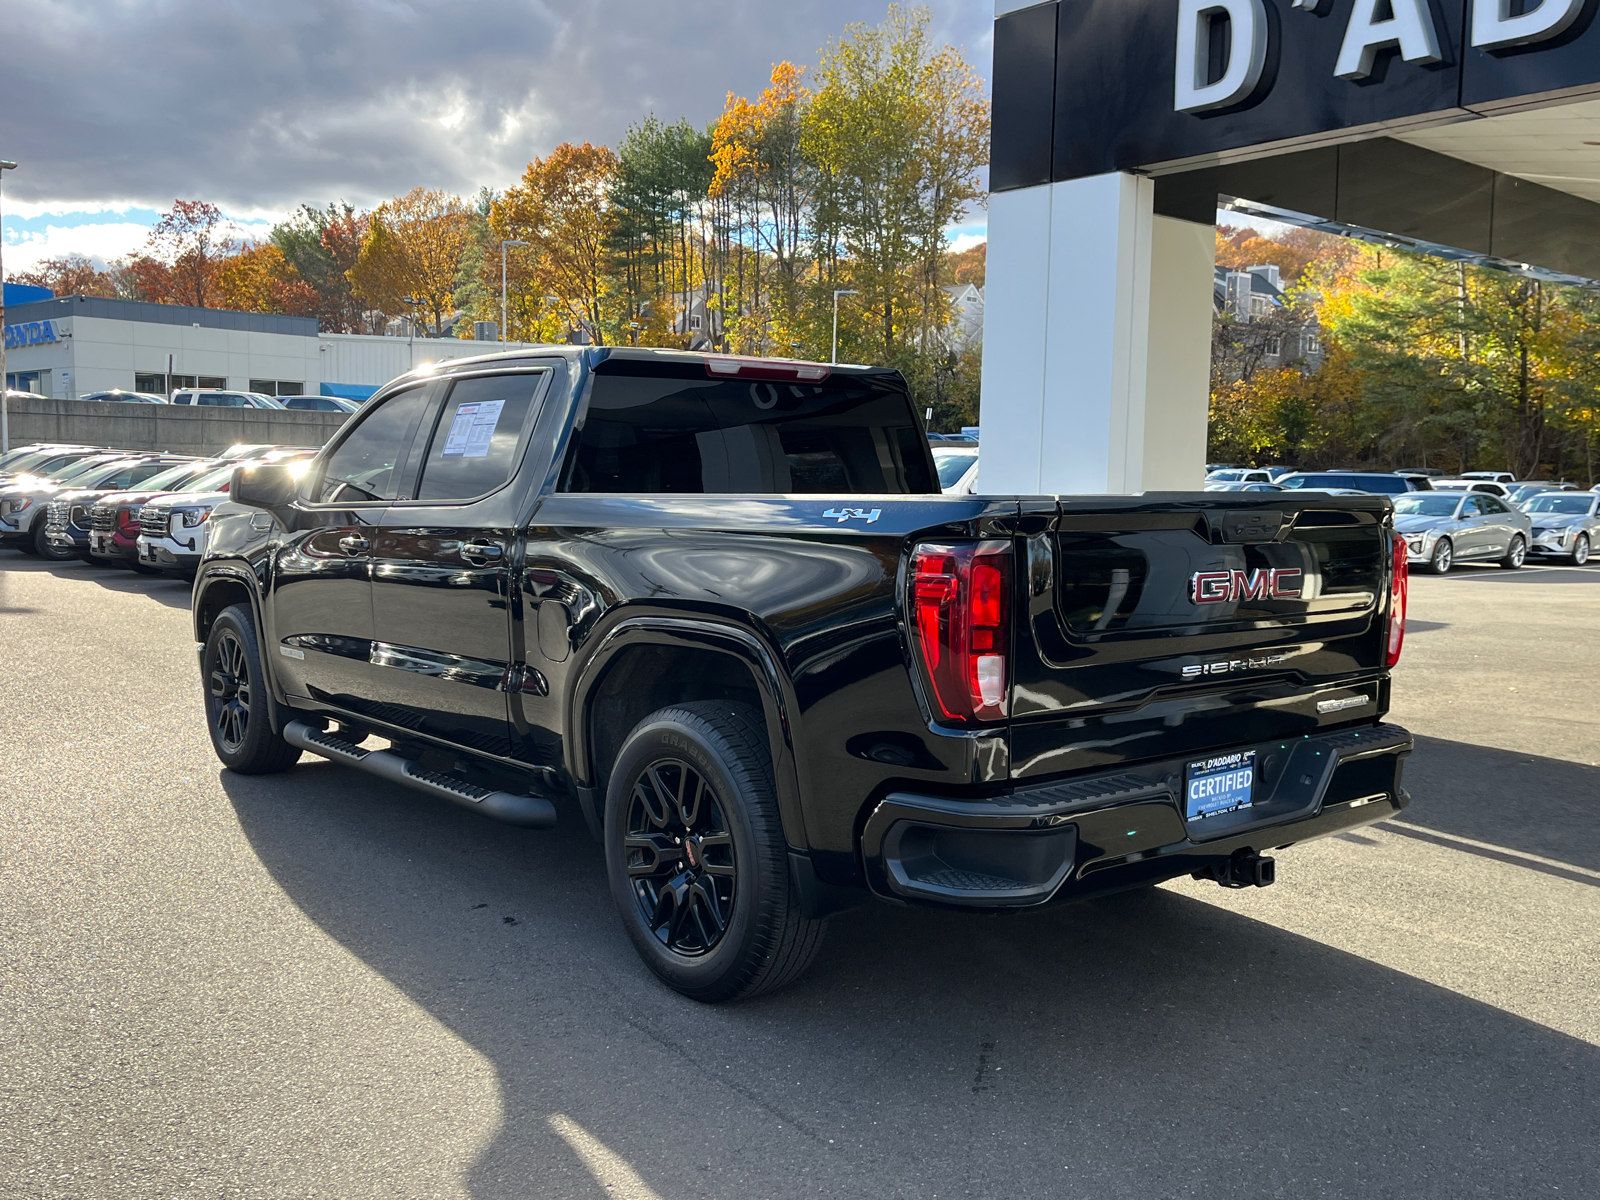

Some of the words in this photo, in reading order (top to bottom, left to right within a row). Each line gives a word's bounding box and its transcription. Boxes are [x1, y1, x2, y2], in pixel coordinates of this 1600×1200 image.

[1174, 0, 1586, 113] DA
[1188, 567, 1302, 605] GMC
[661, 731, 725, 791] GRABBER
[1207, 753, 1241, 769] D'ADDARIO
[1190, 770, 1253, 800] CERTIFIED
